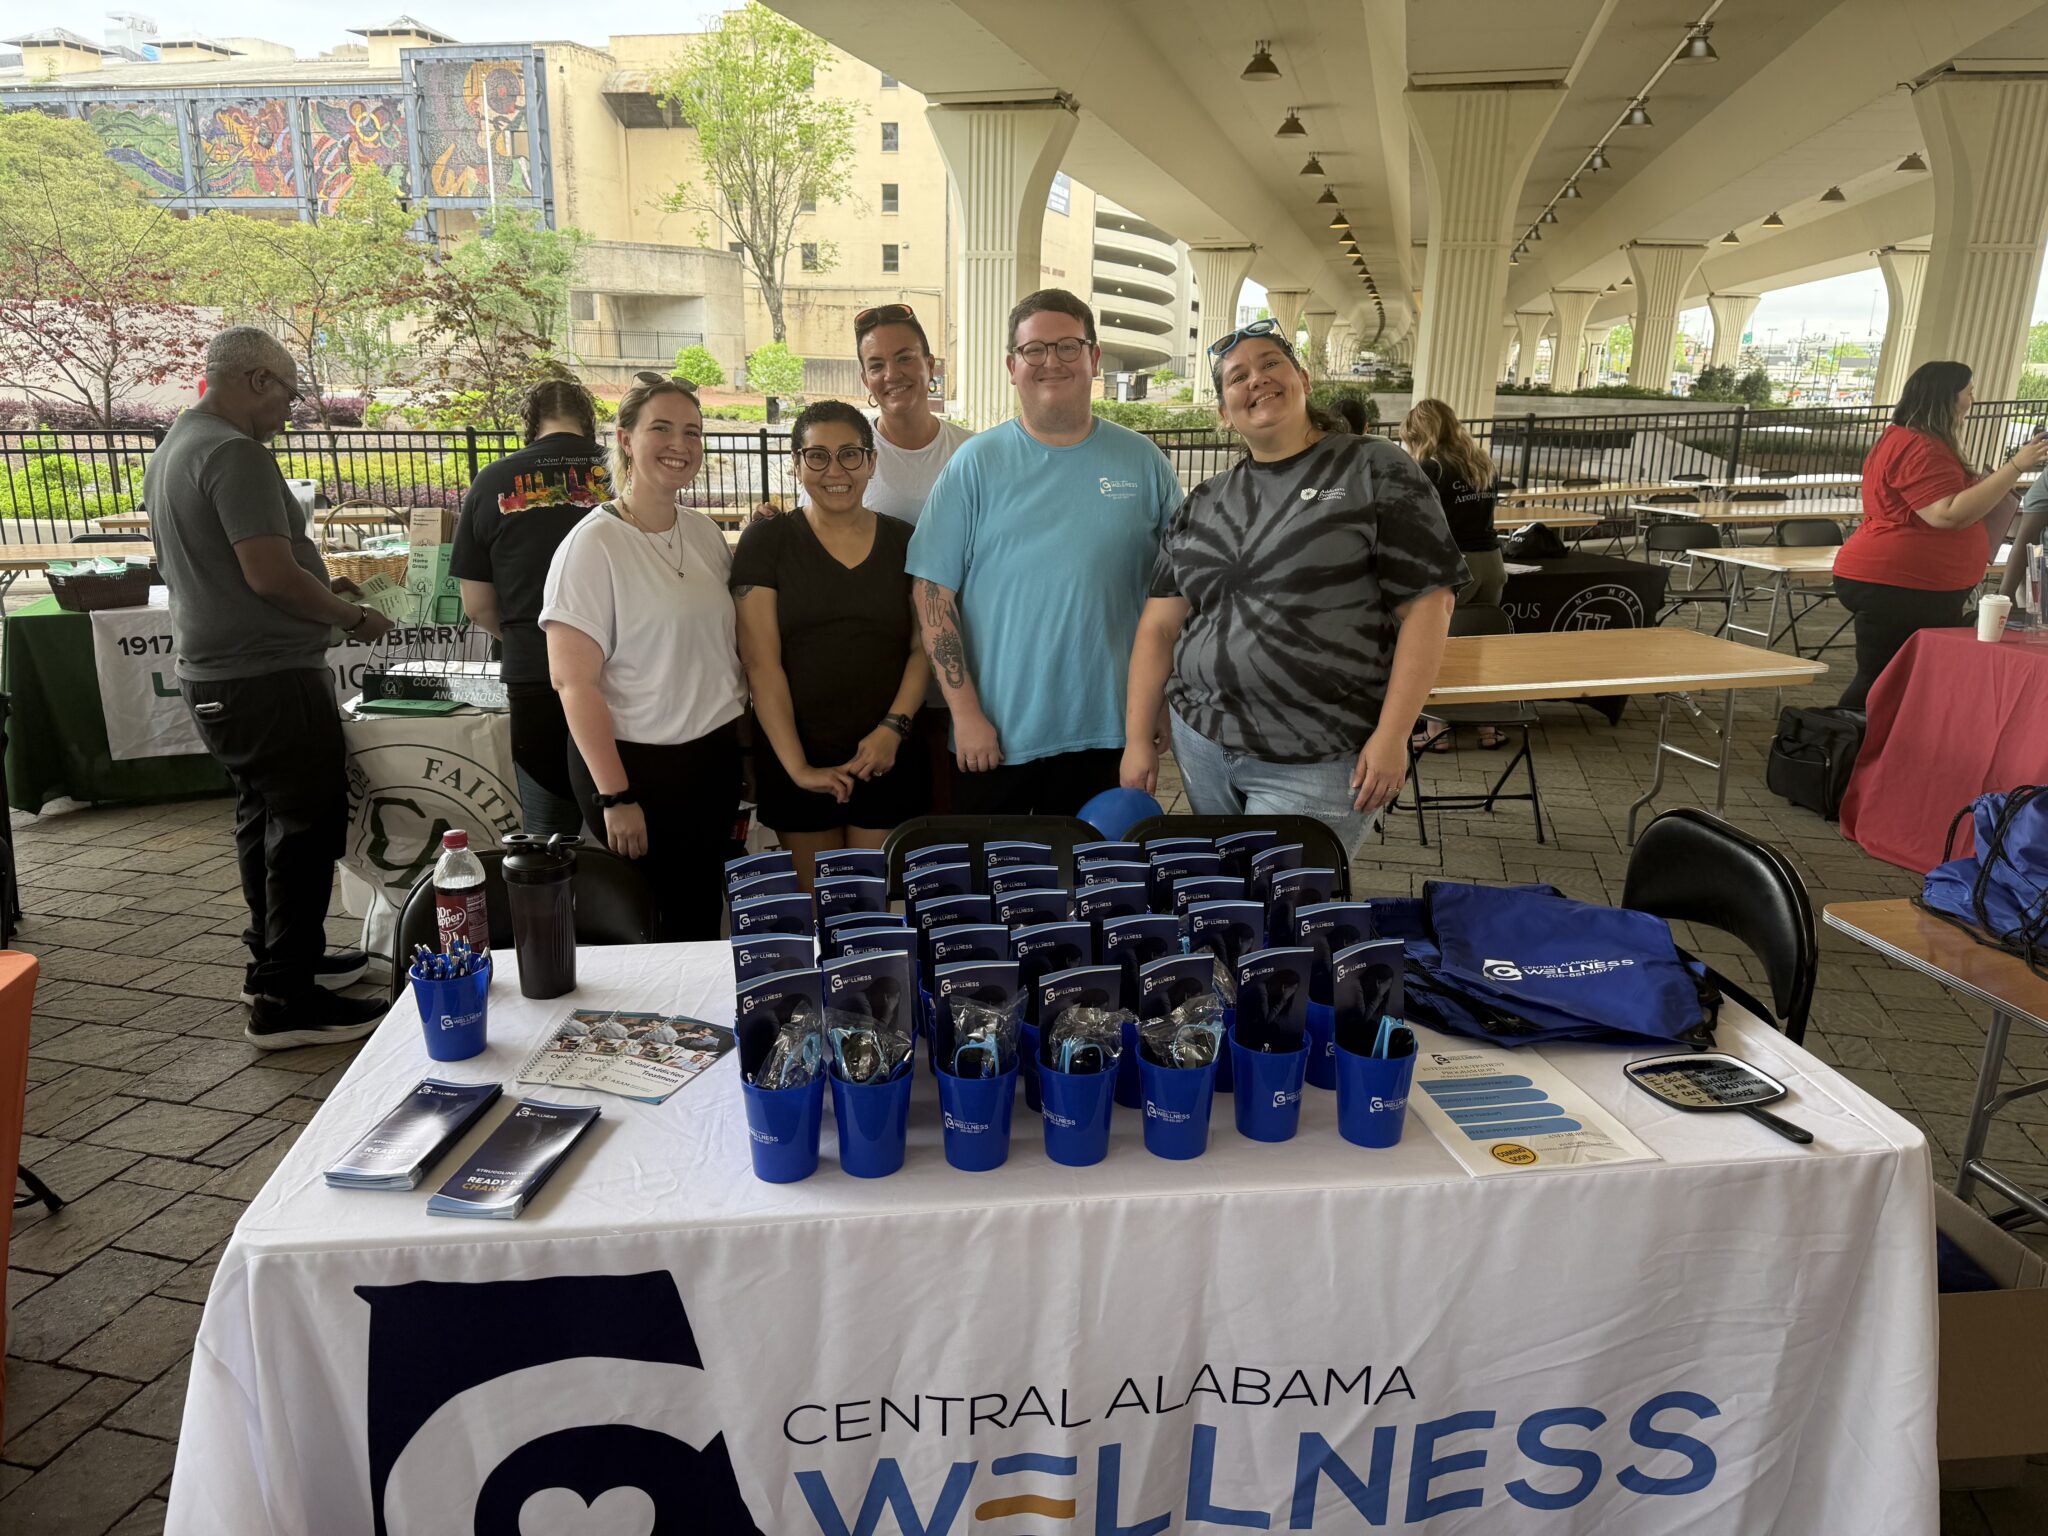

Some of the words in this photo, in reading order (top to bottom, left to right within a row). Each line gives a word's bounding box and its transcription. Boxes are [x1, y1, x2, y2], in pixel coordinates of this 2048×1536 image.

[543, 456, 559, 464] New
[1575, 592, 1592, 606] NO
[1608, 588, 1640, 614] MORE
[1501, 602, 1542, 619] OUS
[117, 635, 174, 656] 1917
[413, 678, 462, 689] COCAINE
[432, 690, 503, 703] ANONYMOUS
[421, 757, 522, 836] FAITH
[437, 913, 463, 929] epper
[1524, 959, 1635, 976] WELLNESS
[1560, 959, 1599, 967] ALABAMA
[625, 1059, 650, 1069] Opioid
[650, 1065, 684, 1079] Addiction
[642, 1070, 678, 1084] Treatment
[1156, 1110, 1190, 1120] WELLNESS
[955, 1120, 989, 1131] WELLNESS
[1497, 1147, 1526, 1158] COMING
[1509, 1154, 1532, 1163] SOON
[476, 1168, 517, 1176] STRUGGLING
[467, 1176, 508, 1186] READY
[462, 1183, 514, 1193] CHANG
[783, 1385, 1091, 1445] CENTRAL
[1105, 1364, 1416, 1420] ALABAMA
[794, 1391, 1722, 1536] WELLNESS
